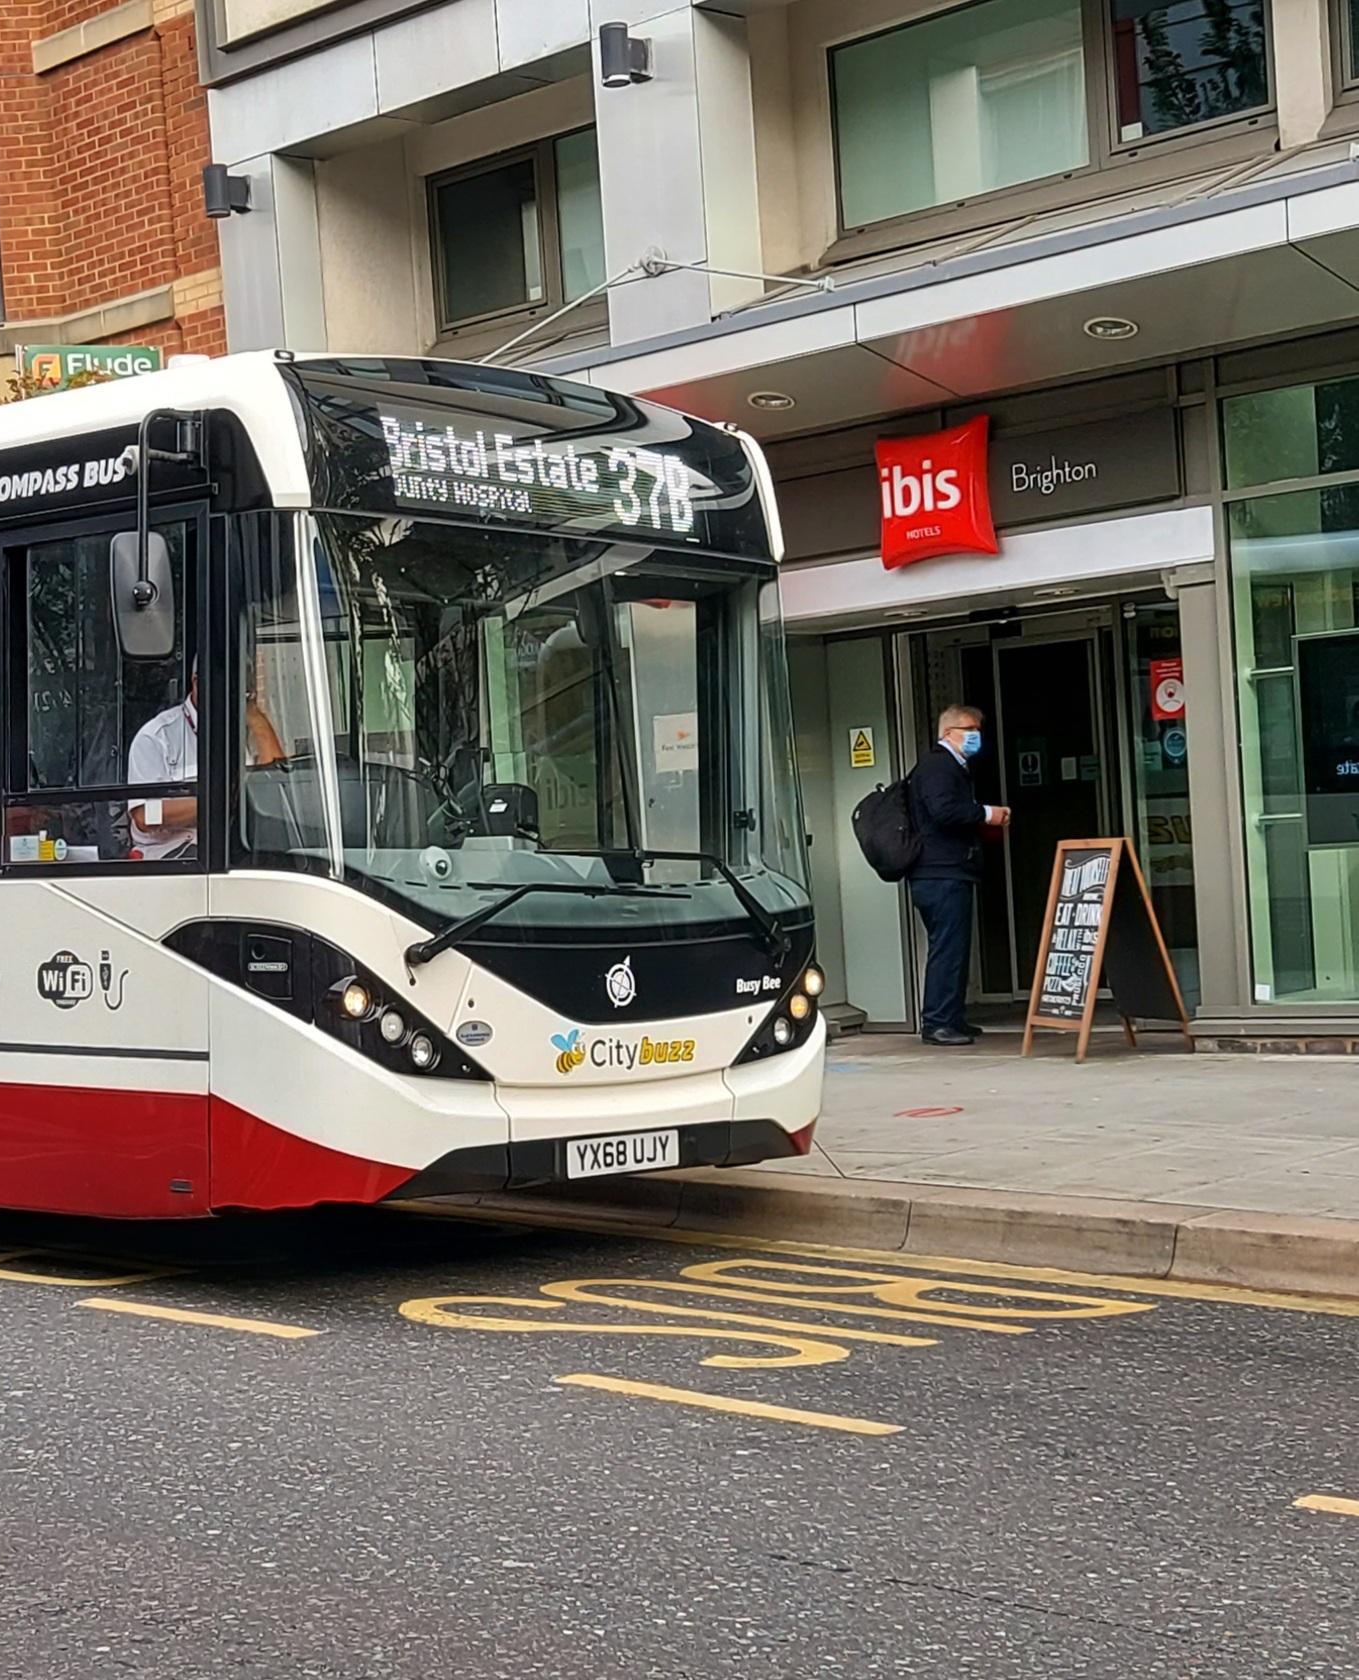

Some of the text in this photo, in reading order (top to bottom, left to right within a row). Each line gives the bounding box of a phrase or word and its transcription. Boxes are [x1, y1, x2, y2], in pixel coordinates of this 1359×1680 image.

[67, 353, 152, 376] Flude
[83, 456, 125, 488] BUS
[380, 416, 695, 533] Bristol Estate 37B
[1012, 456, 1097, 494] Brighton
[880, 460, 962, 519] ibis
[906, 526, 941, 540] HOTELS
[1054, 902, 1074, 926] EAT
[736, 975, 781, 996] Busy Bee
[576, 1135, 670, 1170] YX68 UJY
[398, 1258, 1159, 1368] BUS
